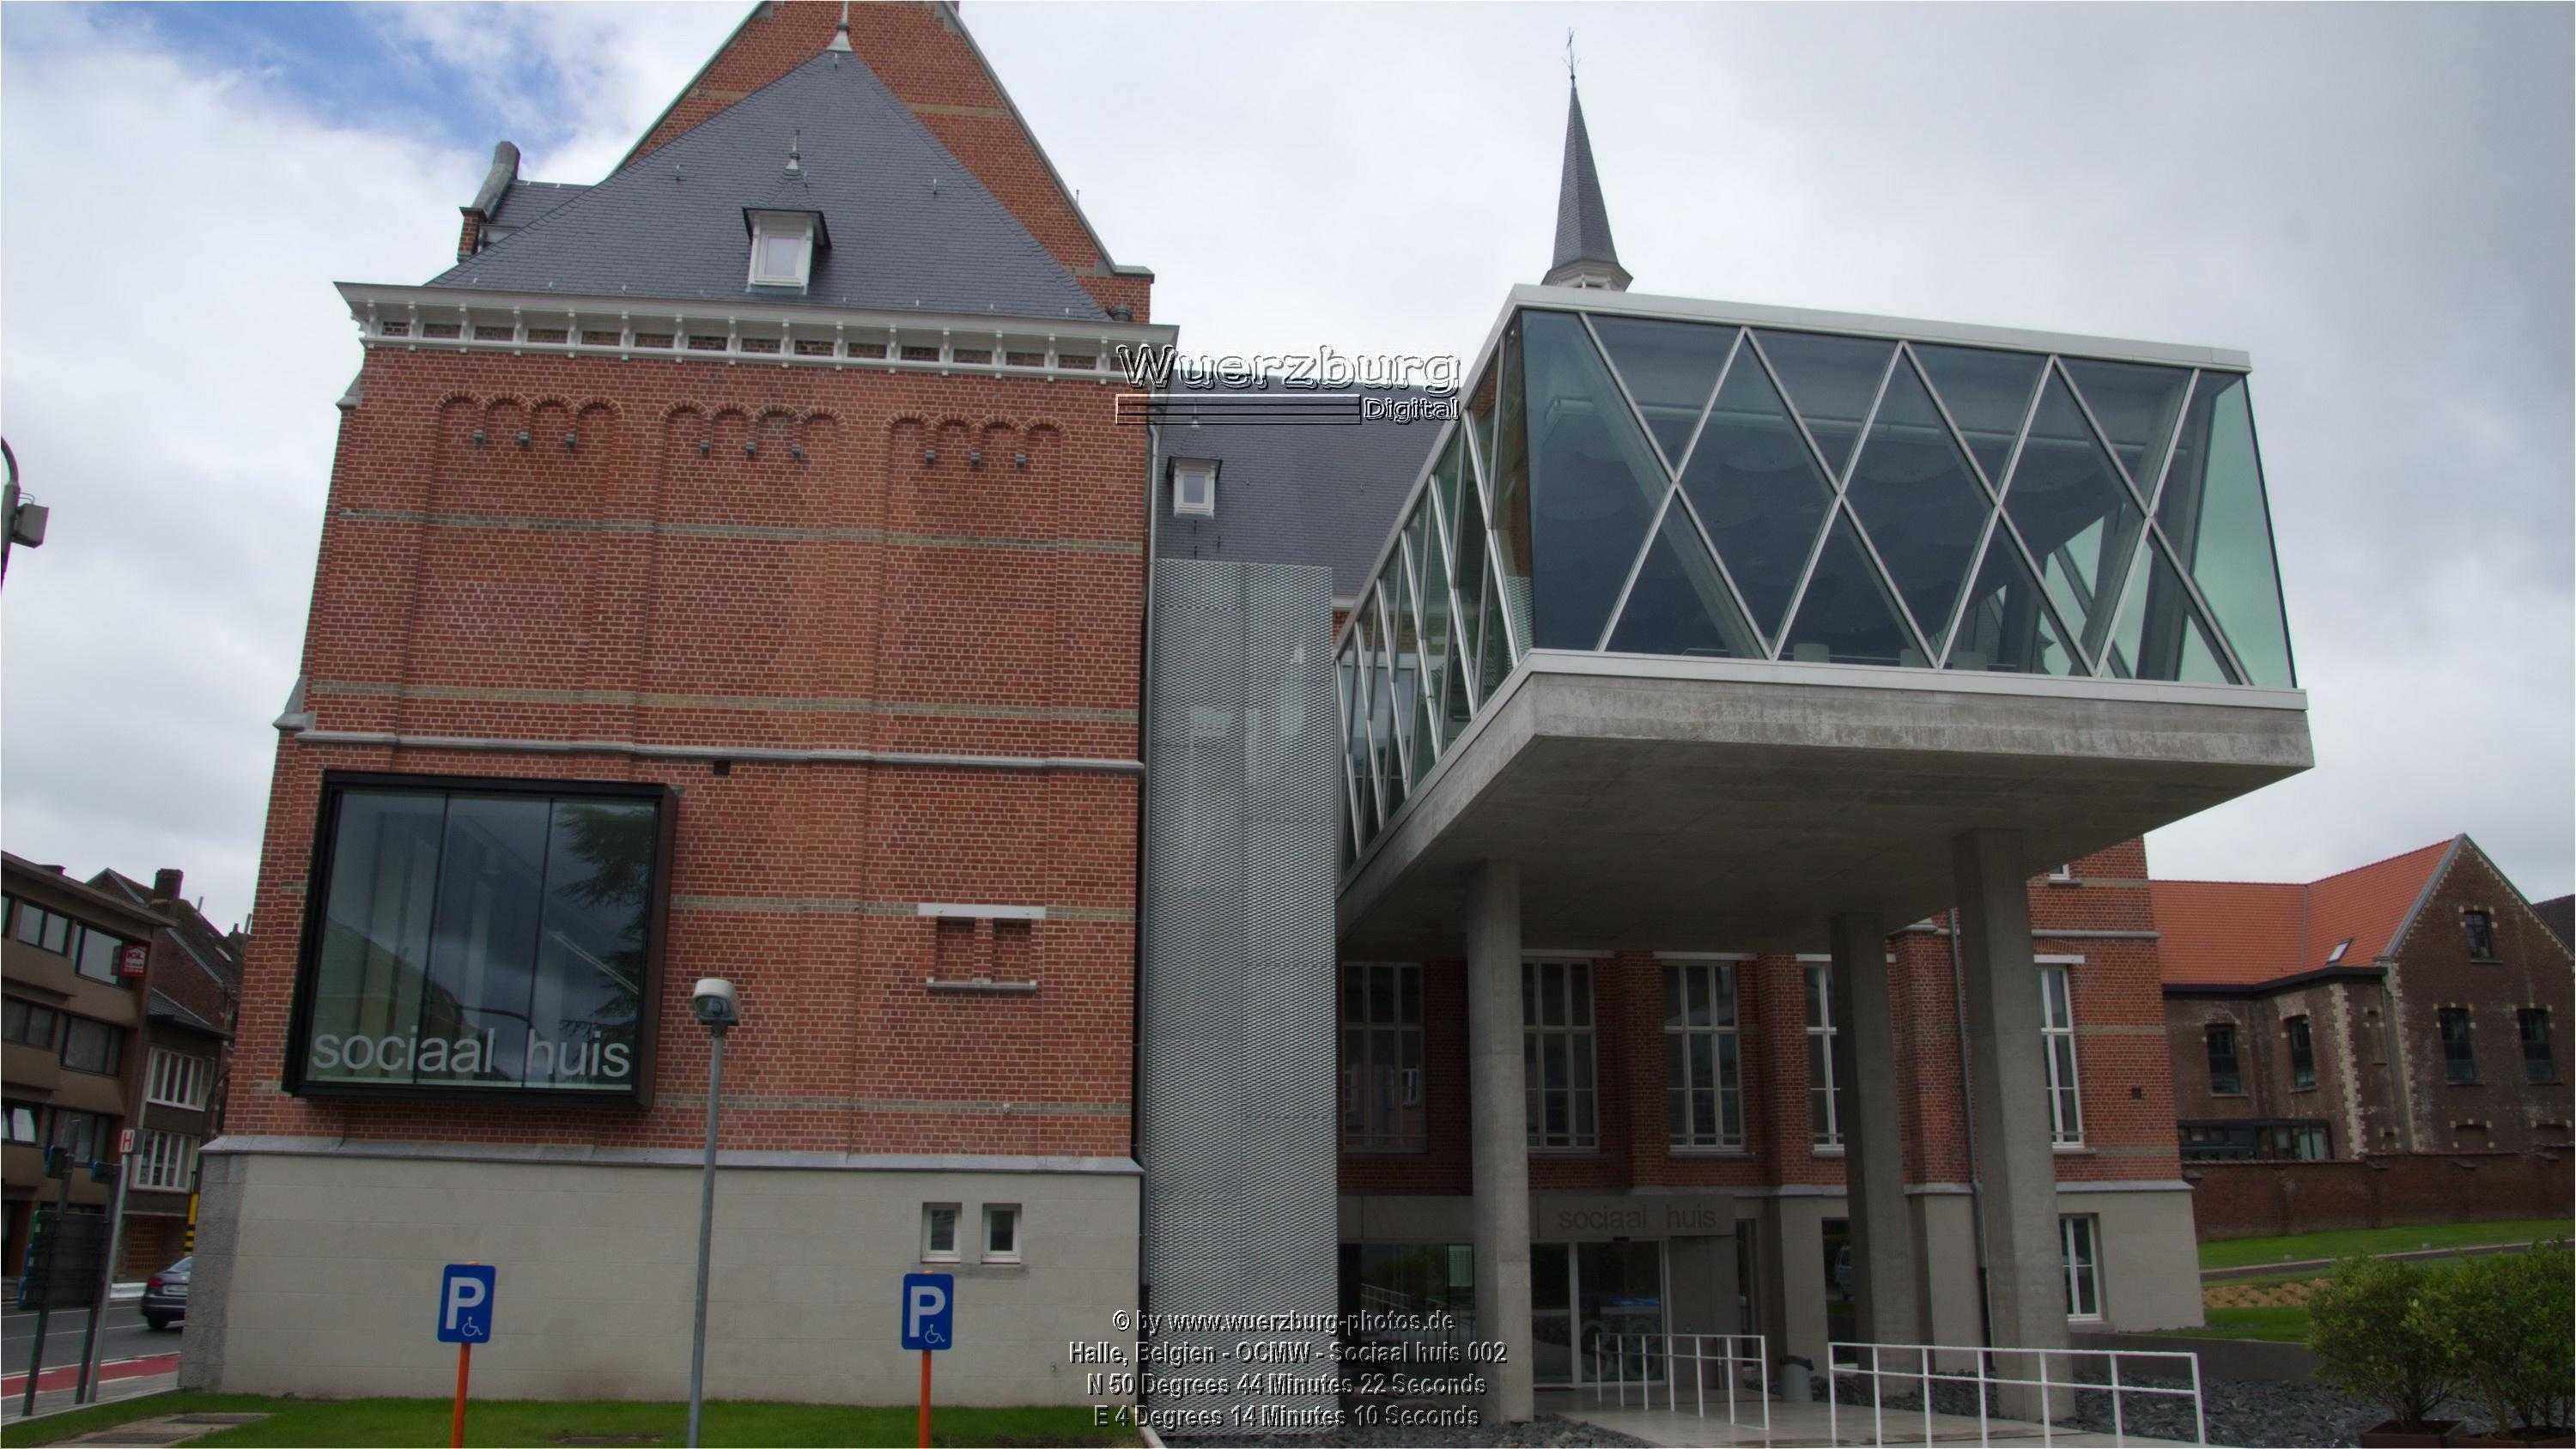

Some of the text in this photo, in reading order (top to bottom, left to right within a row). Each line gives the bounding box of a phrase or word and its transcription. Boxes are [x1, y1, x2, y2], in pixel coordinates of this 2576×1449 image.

[312, 1025, 630, 1077] sociaal huis
[122, 1131, 133, 1151] H
[1558, 1203, 1717, 1230] sociaal huis
[446, 1276, 486, 1330] P
[909, 1285, 945, 1337] P
